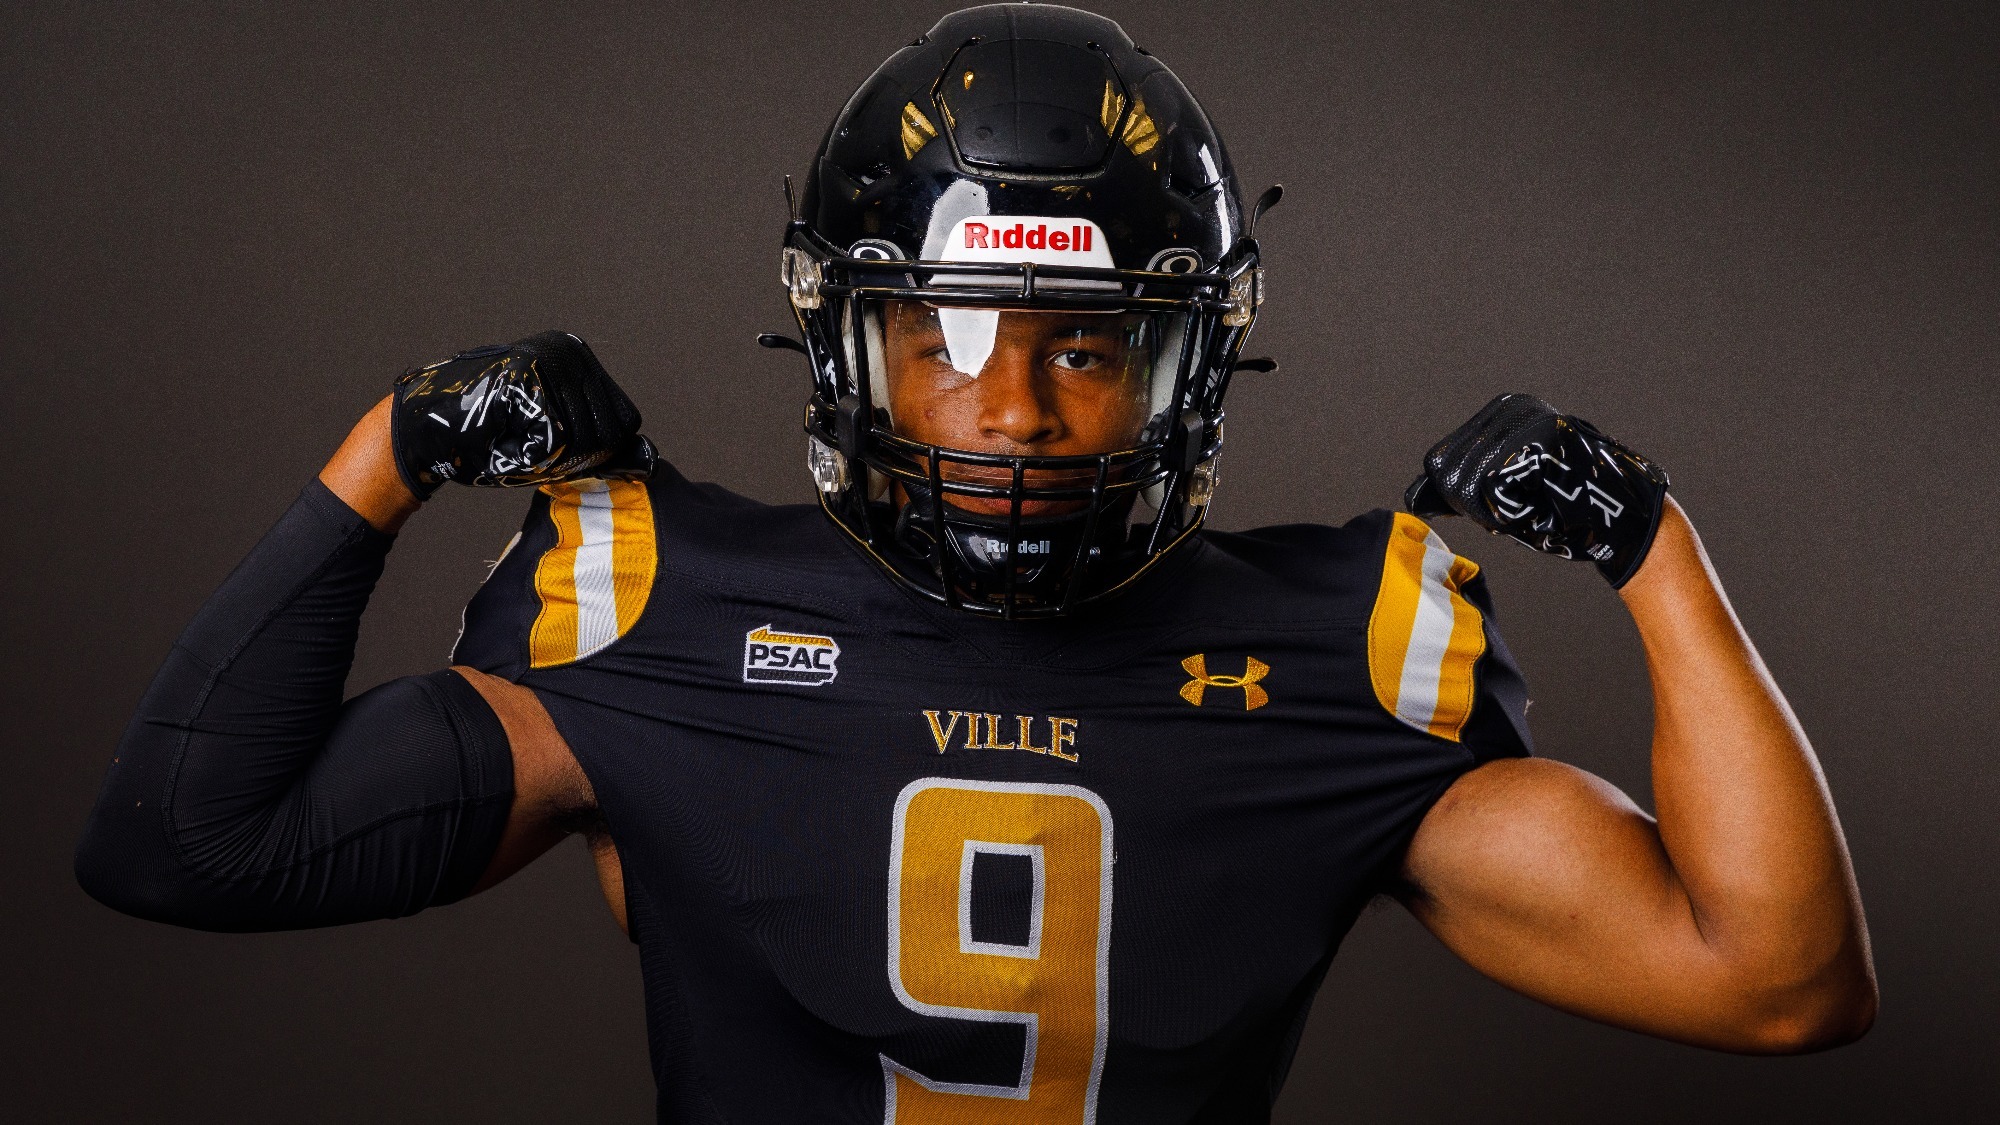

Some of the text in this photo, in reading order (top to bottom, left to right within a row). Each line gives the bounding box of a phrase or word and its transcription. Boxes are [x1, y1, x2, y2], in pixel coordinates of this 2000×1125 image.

[964, 222, 1092, 252] Riddell
[986, 539, 1051, 554] Ridell
[748, 643, 833, 671] PSAC
[922, 709, 1079, 763] VILLE
[879, 777, 1114, 1125] 9
